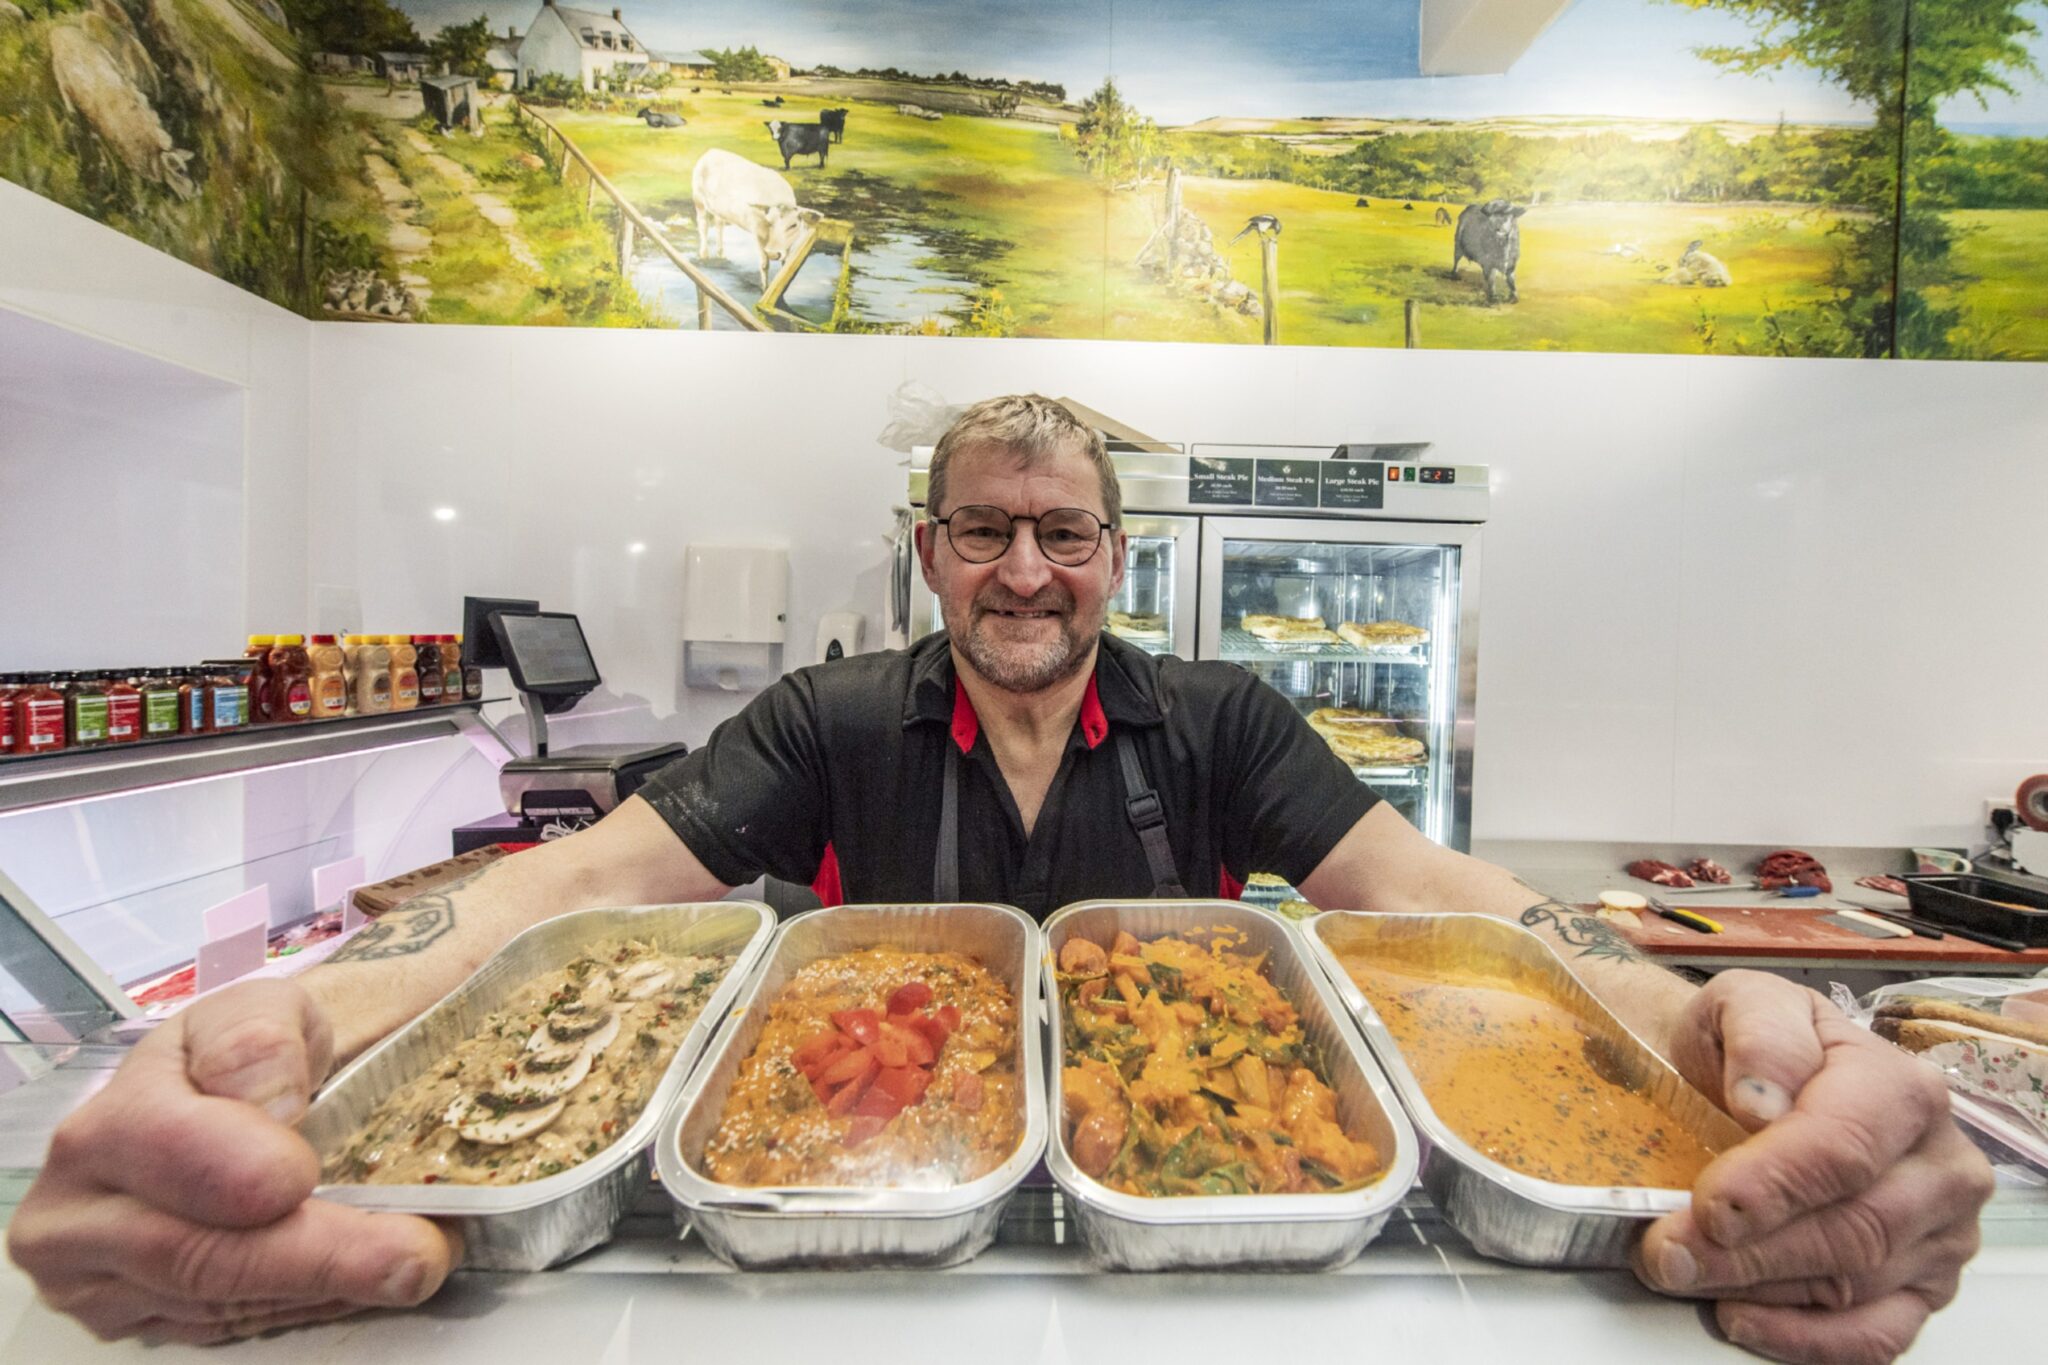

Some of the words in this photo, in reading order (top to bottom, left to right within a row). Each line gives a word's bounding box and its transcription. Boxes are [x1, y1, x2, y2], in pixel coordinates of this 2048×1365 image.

[1216, 473, 1236, 481] Steak
[1325, 477, 1345, 486] Large
[1368, 478, 1380, 486] Pie
